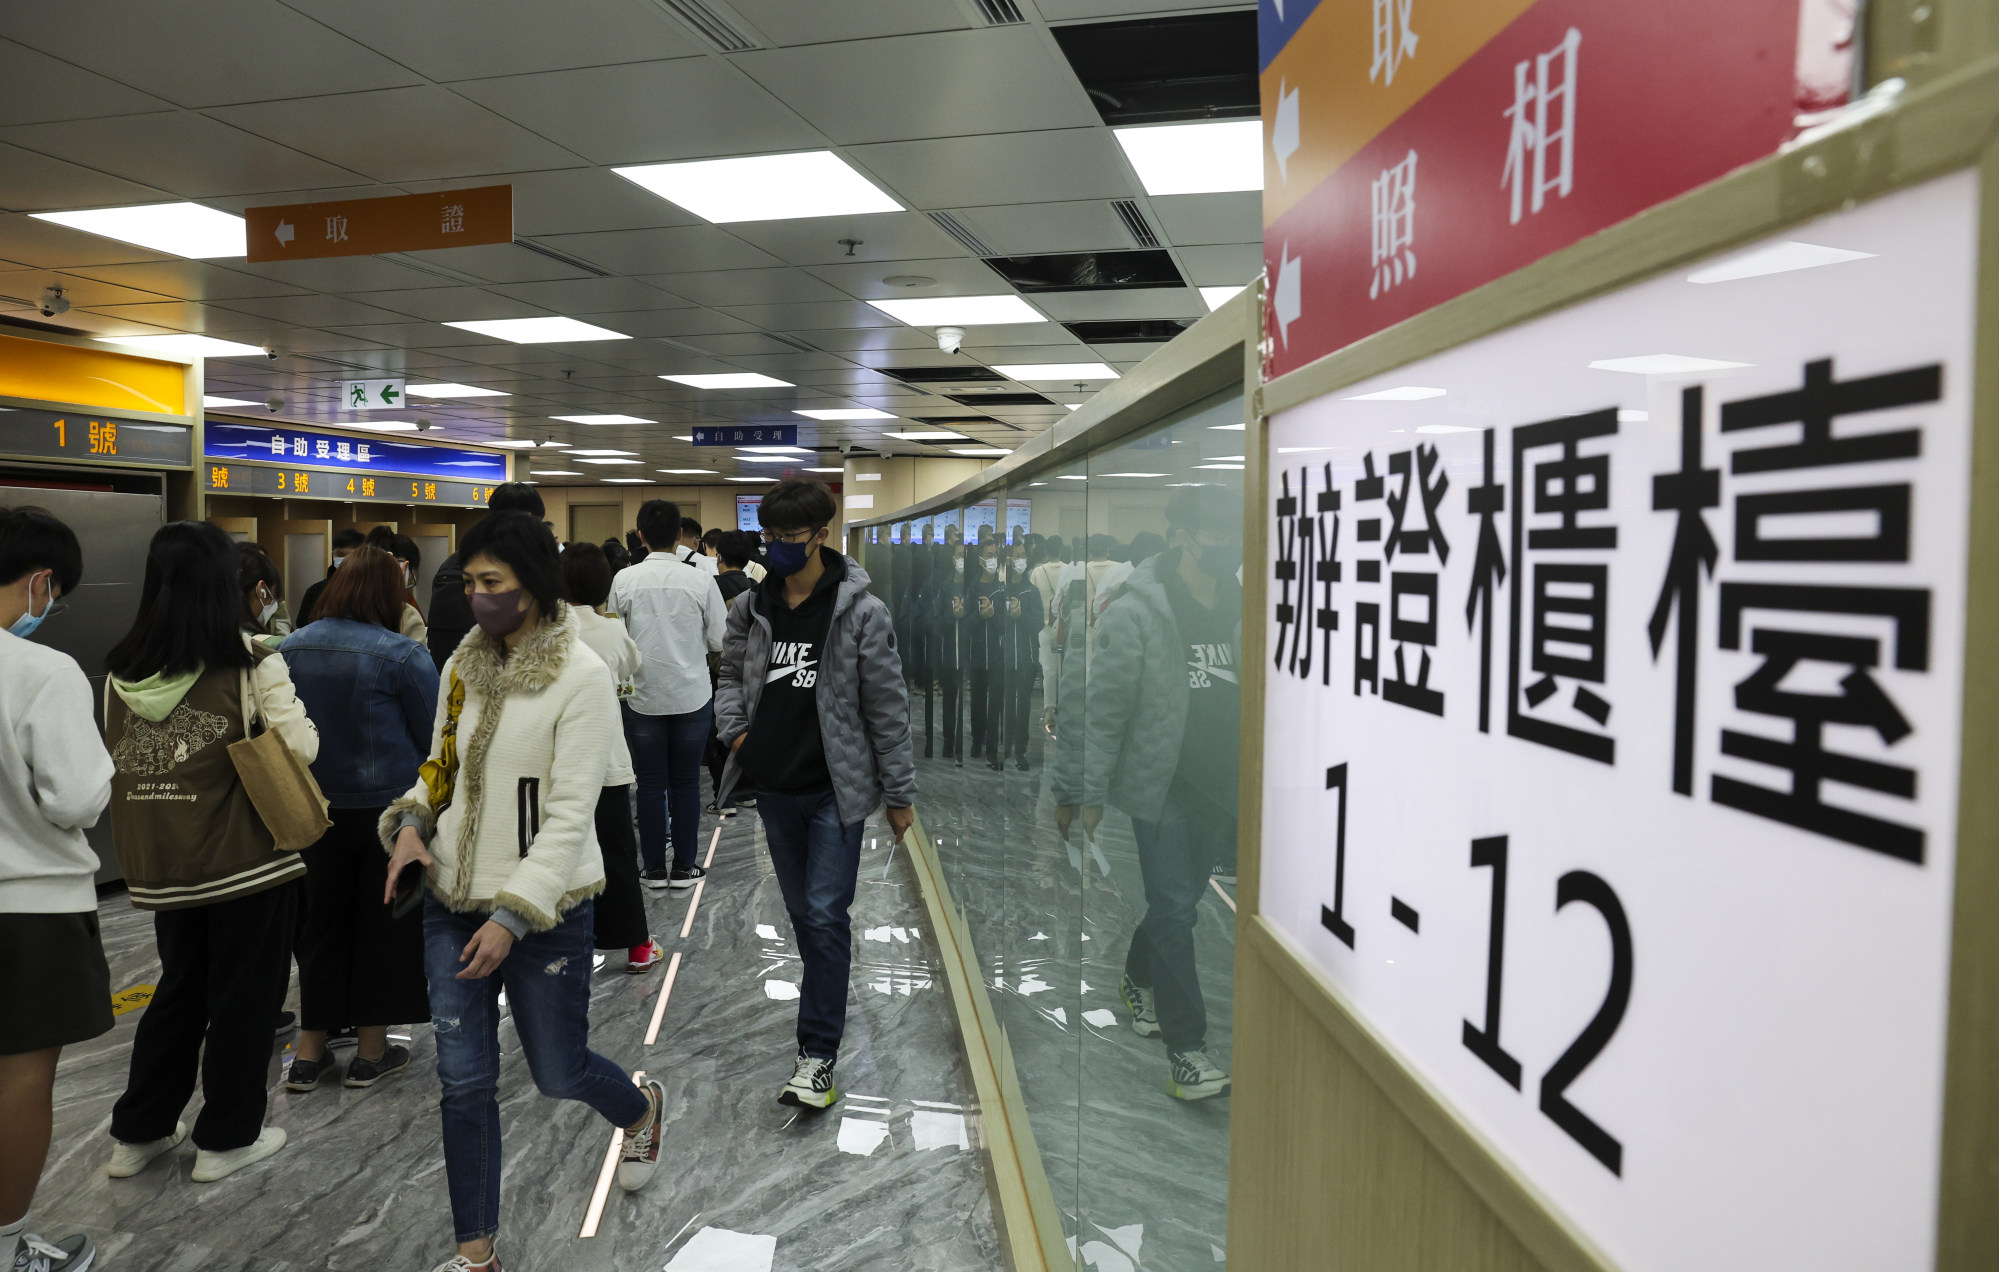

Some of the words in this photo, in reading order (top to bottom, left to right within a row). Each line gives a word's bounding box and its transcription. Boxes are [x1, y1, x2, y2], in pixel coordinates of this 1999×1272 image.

[1369, 28, 1581, 300] 照相
[325, 205, 464, 243] 取證
[271, 435, 370, 462] 自助受理區
[715, 430, 782, 442] 自助受理
[1275, 357, 1944, 867] 辦證櫃檯
[771, 641, 813, 666] NIKE
[791, 669, 817, 688] SB
[1321, 762, 1355, 951] 1
[1462, 834, 1634, 1179] 12
